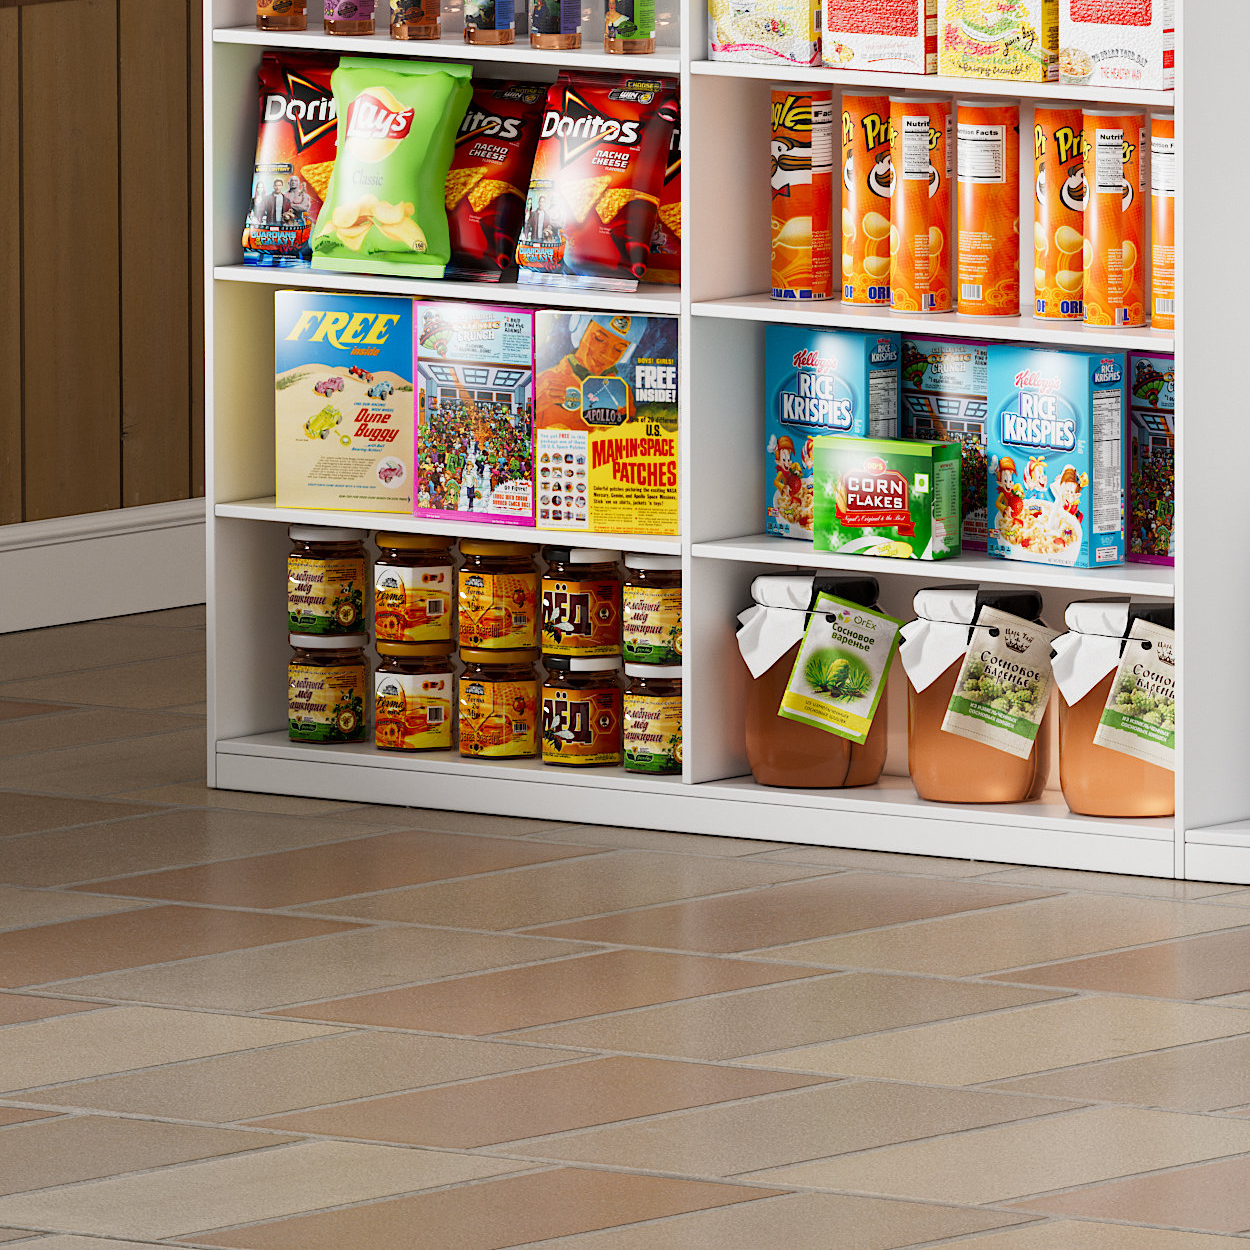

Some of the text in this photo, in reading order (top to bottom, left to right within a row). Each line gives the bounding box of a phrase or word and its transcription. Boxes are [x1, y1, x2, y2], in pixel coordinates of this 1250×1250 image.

[620, 91, 638, 99] WIN
[541, 112, 640, 144] Doritos
[469, 150, 505, 162] CHEESE
[474, 143, 509, 155] NACHO
[596, 150, 630, 161] NACHO
[591, 157, 628, 168] CHEESE
[352, 170, 384, 187] Classic
[284, 310, 401, 350] FREE
[457, 331, 495, 342] CRUNCH
[350, 346, 380, 357] inside
[878, 344, 891, 353] RICE
[793, 348, 838, 373] Kellogg's
[871, 352, 897, 362] KRISPIES
[931, 363, 966, 374] CRUNCH
[1101, 364, 1114, 373] RICE
[636, 366, 677, 389] FREE
[1014, 369, 1061, 394] Kellogg's
[1094, 372, 1121, 383] KRISPIES
[798, 372, 835, 400] RICE
[636, 389, 676, 403] INSIDE!
[781, 392, 853, 429] KRISPIES
[1020, 392, 1057, 421] RICE
[354, 408, 391, 424] Dune
[585, 409, 616, 421] APOLLO
[354, 423, 400, 442] Buggy
[646, 425, 662, 437] U.S.
[1001, 412, 1076, 453] KRISPIES
[613, 461, 677, 487] PATCHES
[848, 478, 903, 495] CORN
[848, 494, 903, 509] FLAKES
[854, 616, 877, 631] OrEx
[832, 622, 875, 645] Сосновое
[832, 632, 870, 652] варенье
[981, 651, 1040, 681] Сосновое
[984, 665, 1030, 688] варенье
